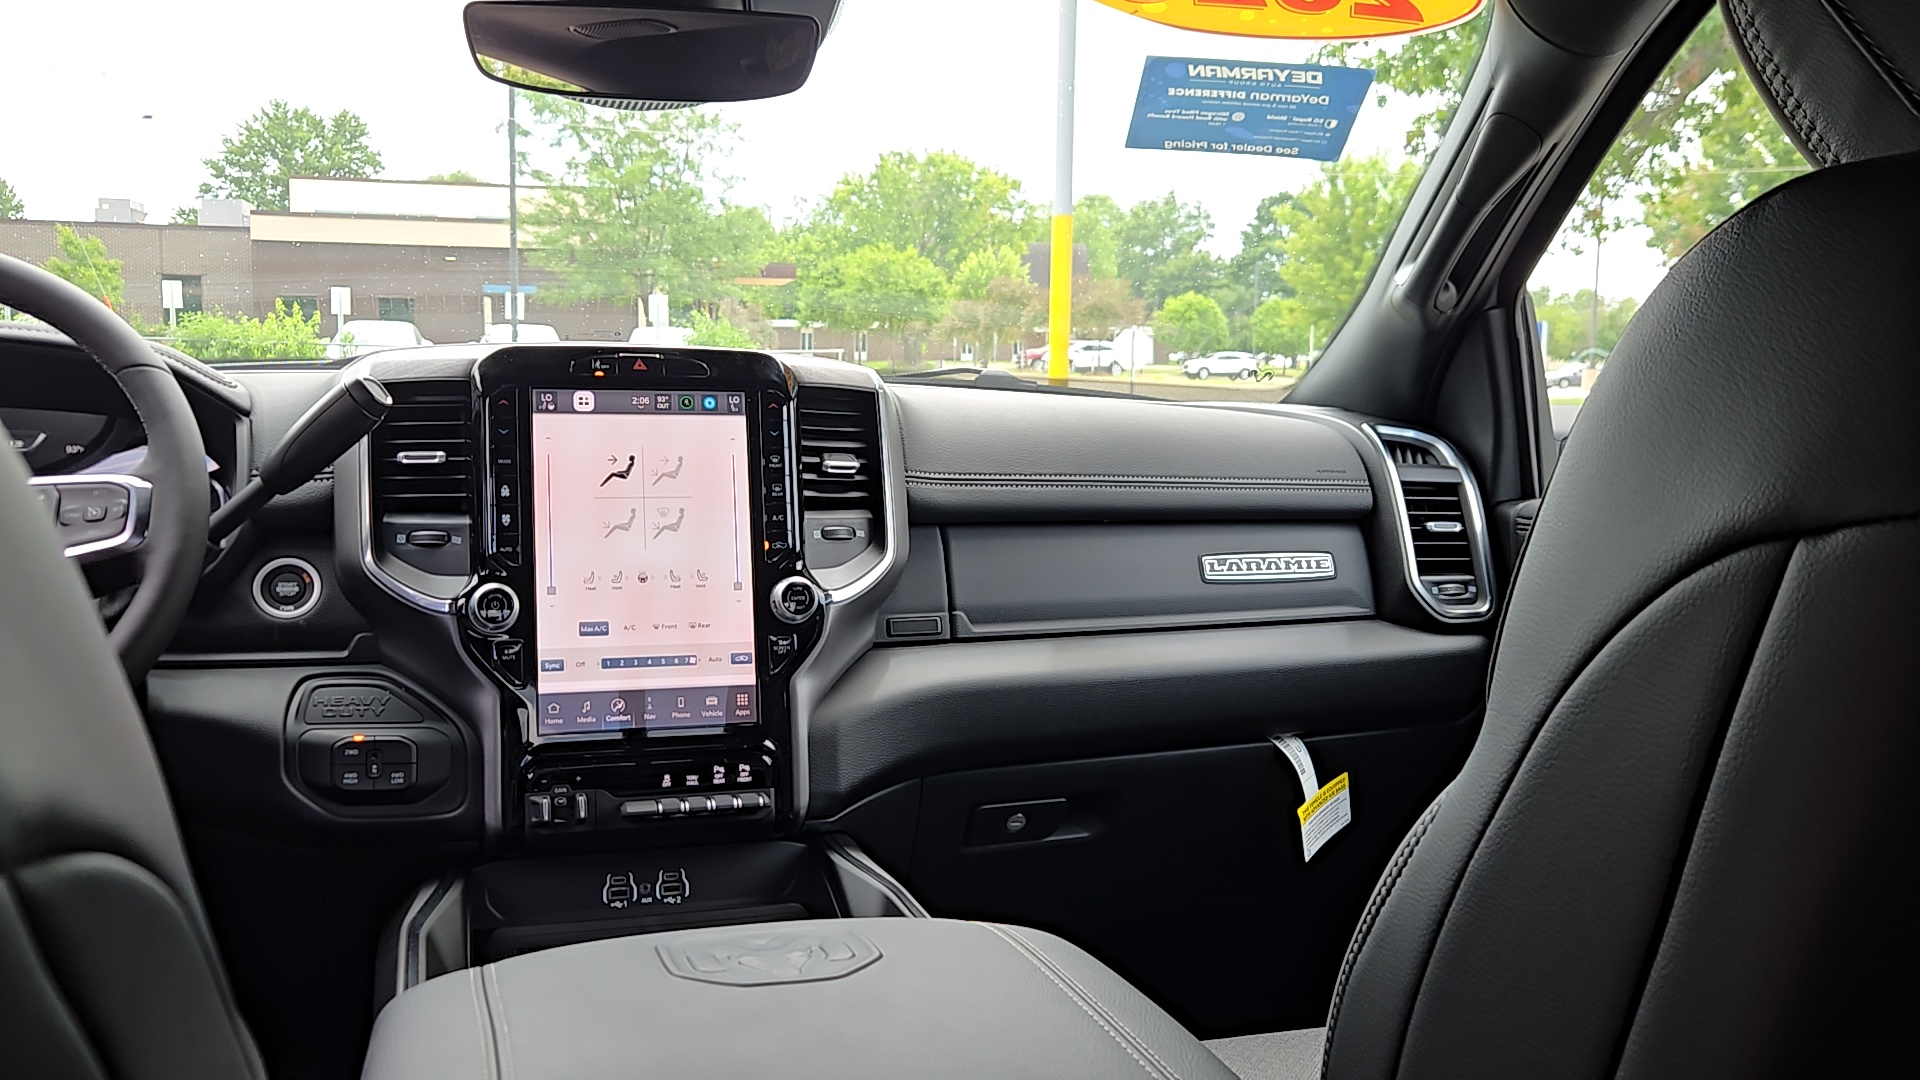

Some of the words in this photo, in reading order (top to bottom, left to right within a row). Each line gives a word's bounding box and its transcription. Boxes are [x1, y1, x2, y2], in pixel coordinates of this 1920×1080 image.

[631, 396, 650, 405] 2:06
[728, 395, 740, 404] LO
[1206, 558, 1332, 574] LARAMIE
[594, 624, 607, 632] A/C
[697, 621, 711, 629] Rear
[544, 661, 561, 671] Sync
[312, 695, 392, 708] HEAVY
[321, 706, 387, 719] DUTY
[671, 711, 691, 719] Phone
[701, 709, 724, 717] Vehicle
[735, 708, 751, 717] Apps
[544, 717, 564, 725] Home
[576, 715, 597, 723] Media
[605, 714, 632, 722] Comfort
